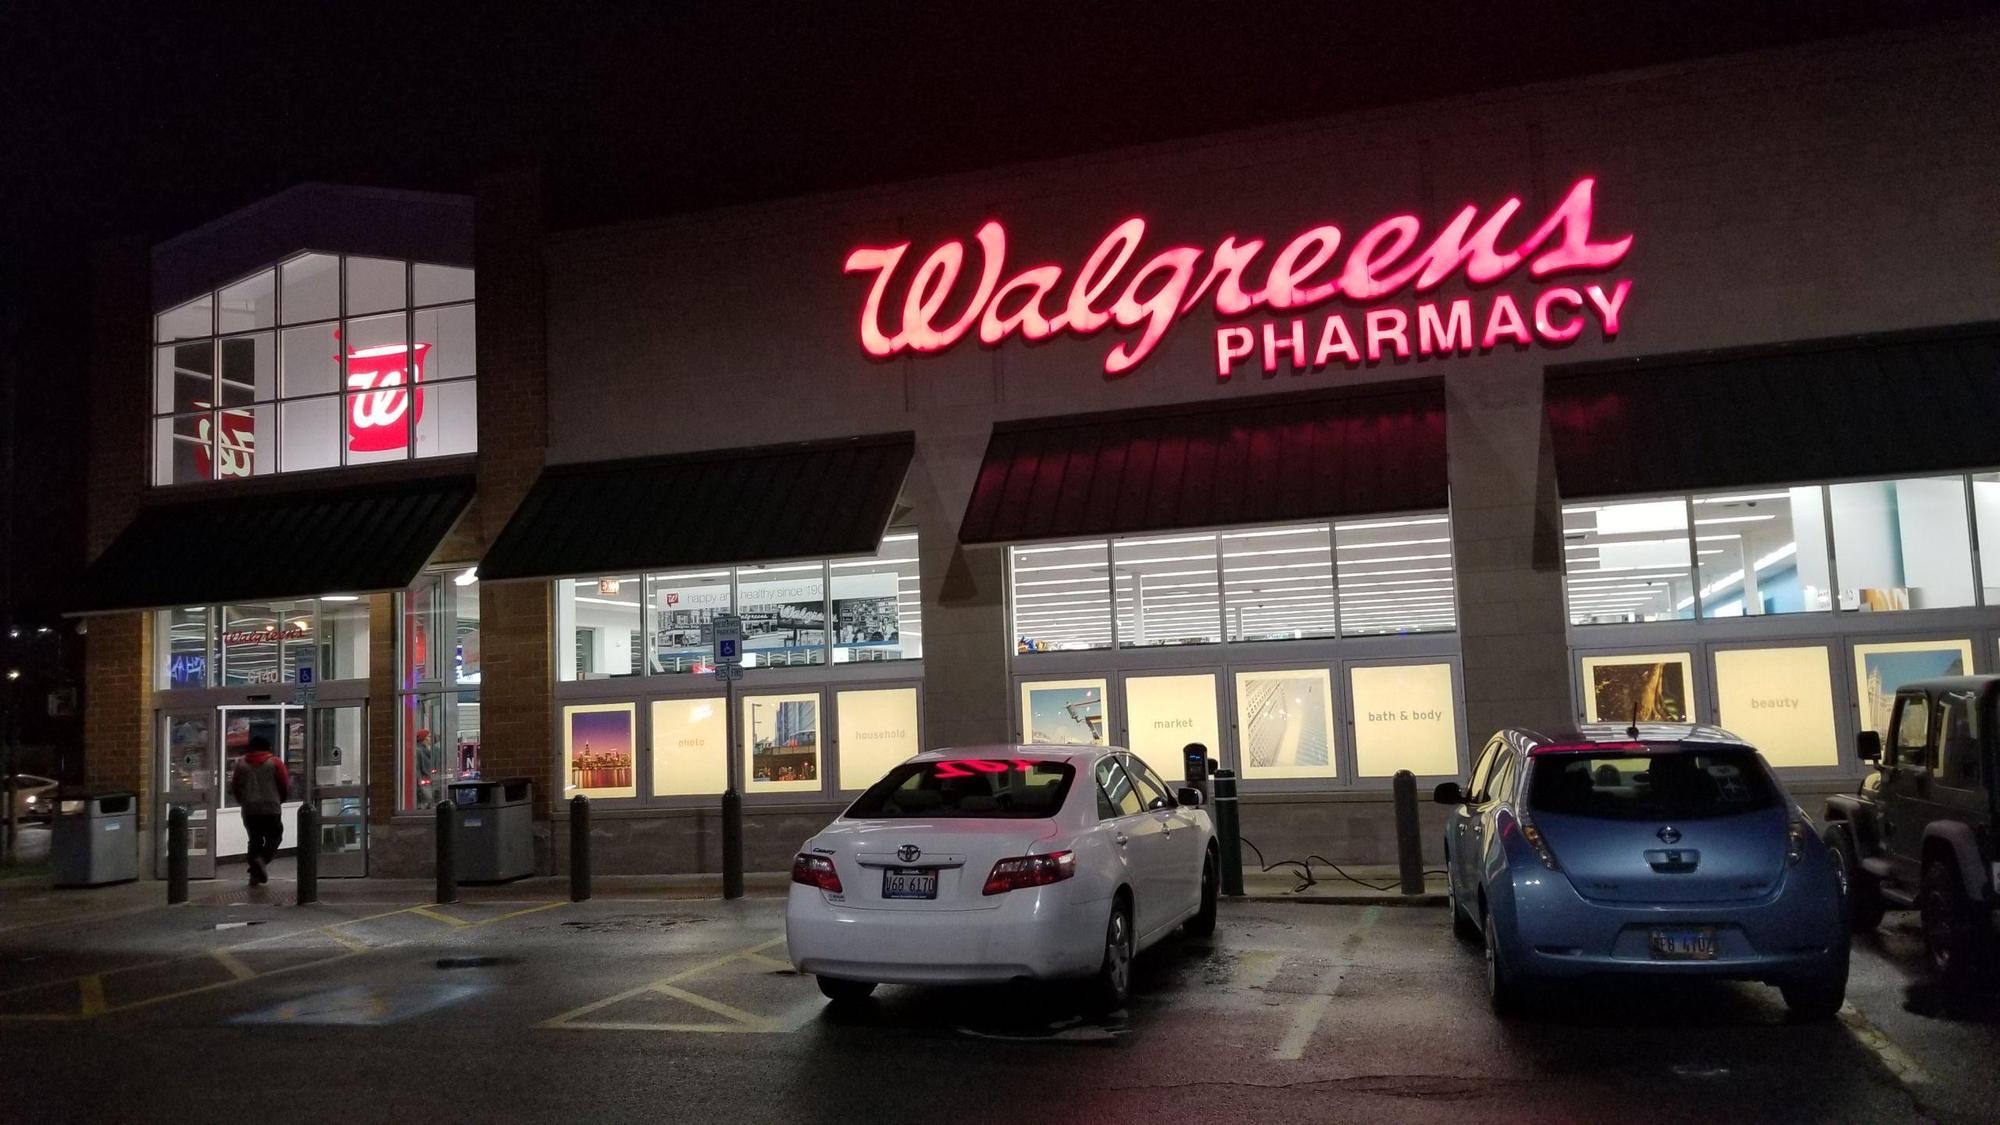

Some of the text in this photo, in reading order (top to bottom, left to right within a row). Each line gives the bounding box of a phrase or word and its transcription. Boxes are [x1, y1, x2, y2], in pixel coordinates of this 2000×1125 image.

[844, 177, 1634, 376] Walgreens
[1217, 281, 1632, 378] PHARMACY
[687, 591, 717, 604] happy
[739, 588, 776, 600] healthy
[776, 585, 803, 598] since
[807, 583, 823, 594] 190
[1751, 698, 1799, 710] beauty
[1368, 709, 1442, 721] bath & body
[1153, 717, 1193, 729] market
[855, 728, 906, 741] household
